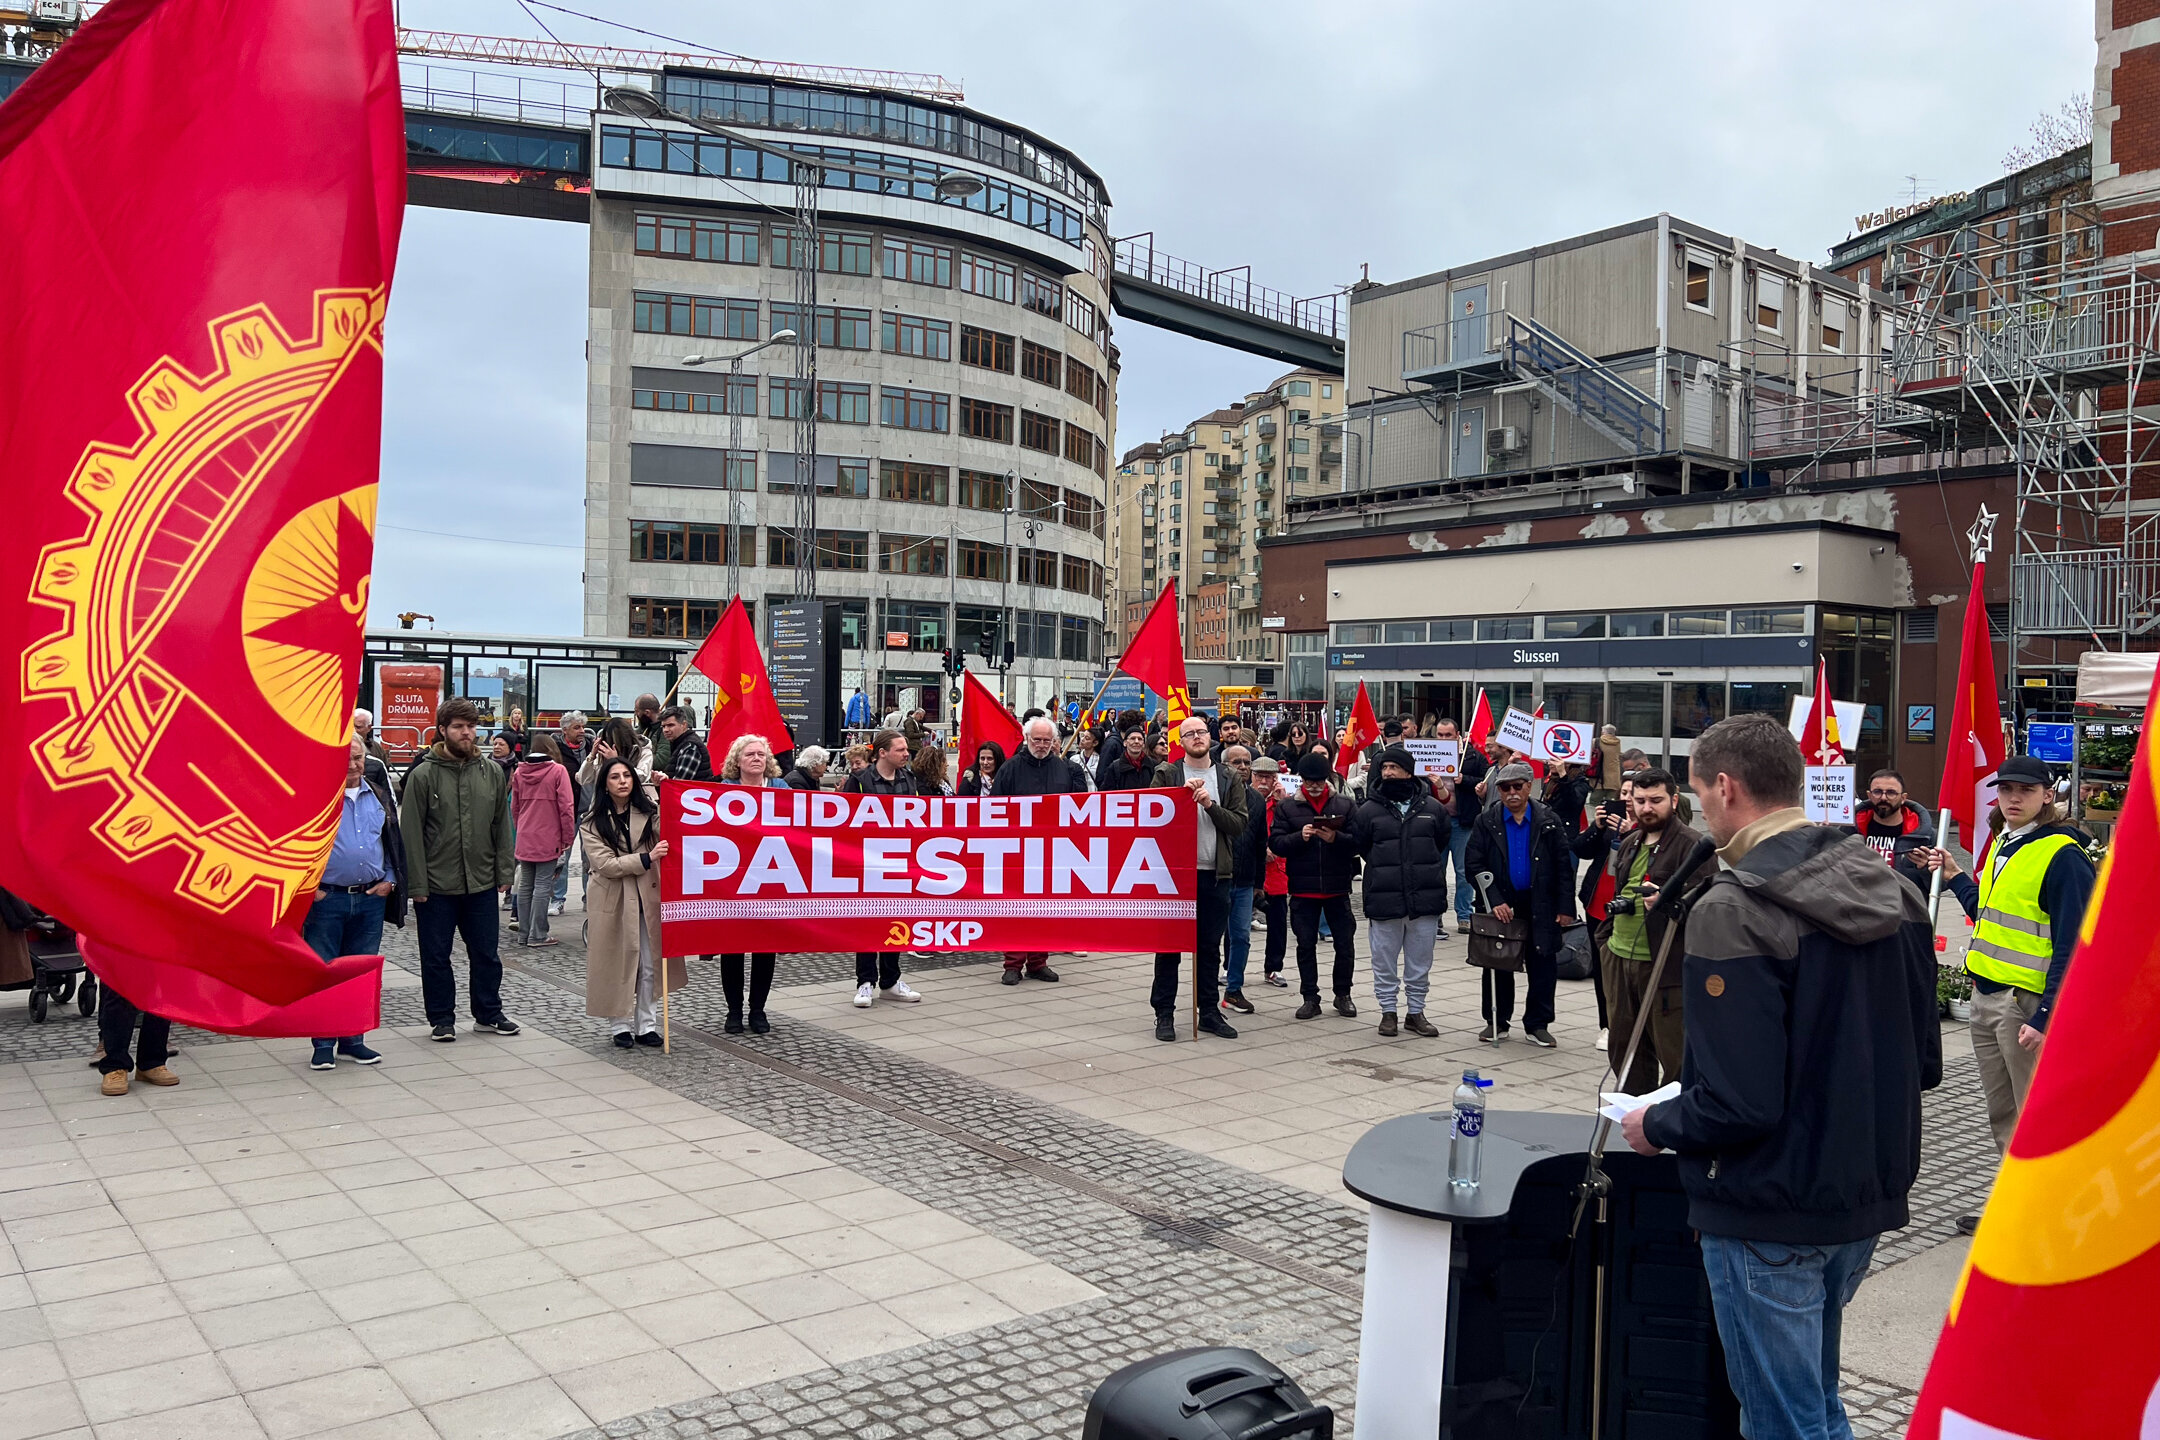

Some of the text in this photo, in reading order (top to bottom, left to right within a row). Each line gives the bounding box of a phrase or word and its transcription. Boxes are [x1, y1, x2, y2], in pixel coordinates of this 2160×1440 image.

[1855, 191, 1968, 233] Wallenstam
[1513, 649, 1559, 663] Slussen
[395, 694, 423, 703] SLUTA
[388, 703, 430, 714] DRÖMMA
[1509, 712, 1533, 726] Lasting
[1505, 721, 1530, 734] through
[680, 788, 1175, 828] SOLIDARITET MED
[682, 835, 1179, 896] PALESTINA
[911, 921, 984, 946] SKP
[1458, 1109, 1481, 1124] Aqua
